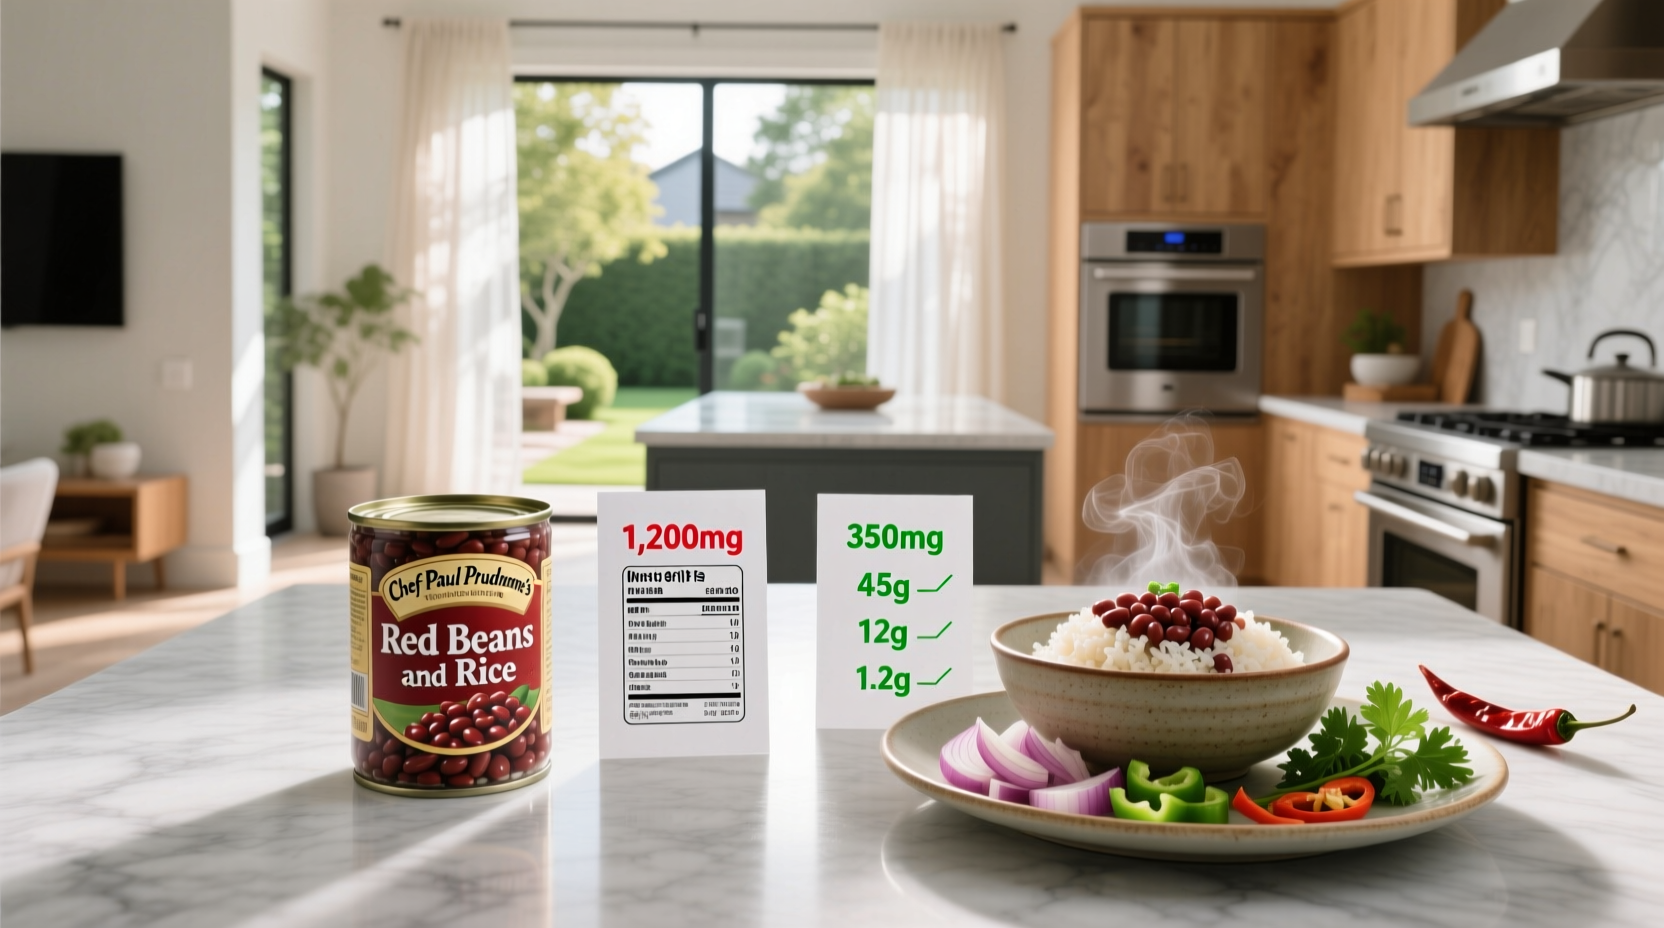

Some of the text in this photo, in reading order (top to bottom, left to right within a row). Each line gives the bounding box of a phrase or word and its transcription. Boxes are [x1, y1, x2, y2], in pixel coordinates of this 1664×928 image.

[622, 523, 744, 556] 1,200mg
[846, 523, 944, 556] 350mg
[388, 572, 423, 602] Chef
[425, 566, 462, 591] Paul
[856, 572, 910, 605] 45g
[380, 622, 534, 656] Red Beans
[858, 618, 908, 651] 12g
[401, 656, 517, 687] and Rice
[856, 664, 911, 697] 1.2g
